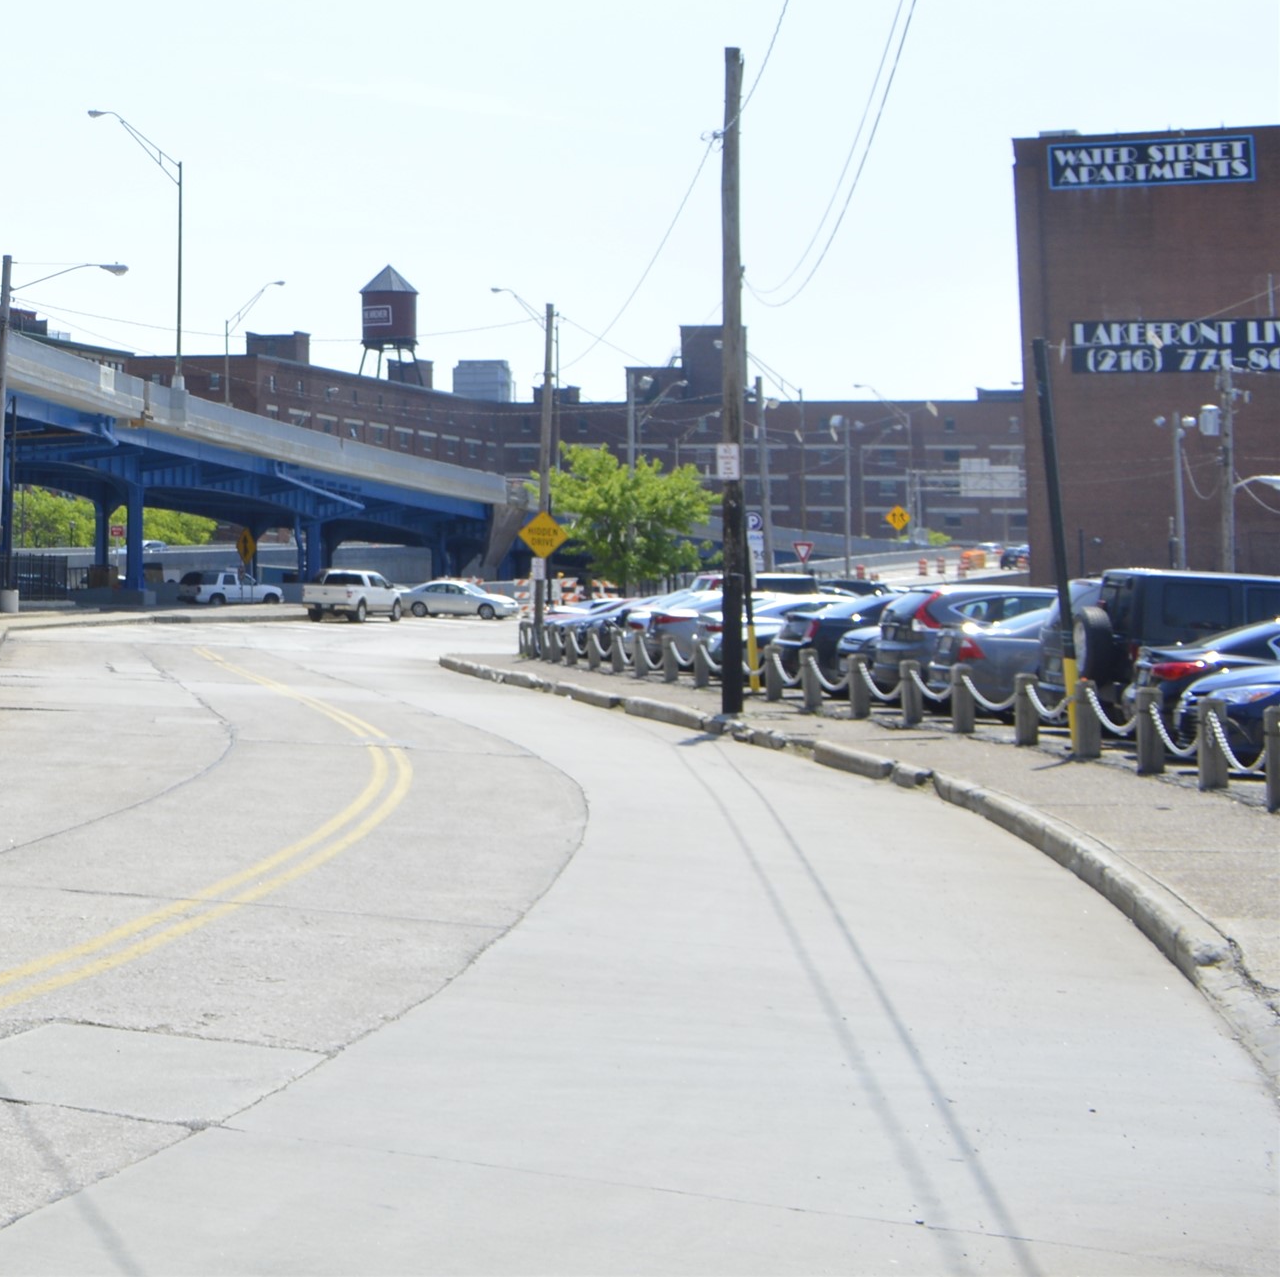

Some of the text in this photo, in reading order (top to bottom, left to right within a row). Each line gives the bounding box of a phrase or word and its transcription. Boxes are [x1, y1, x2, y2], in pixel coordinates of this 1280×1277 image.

[1053, 141, 1247, 166] WATER STREET
[1059, 159, 1249, 184] APARTMENTS
[1073, 321, 1237, 346] LAKEFRONT
[1087, 348, 1163, 372] (216)
